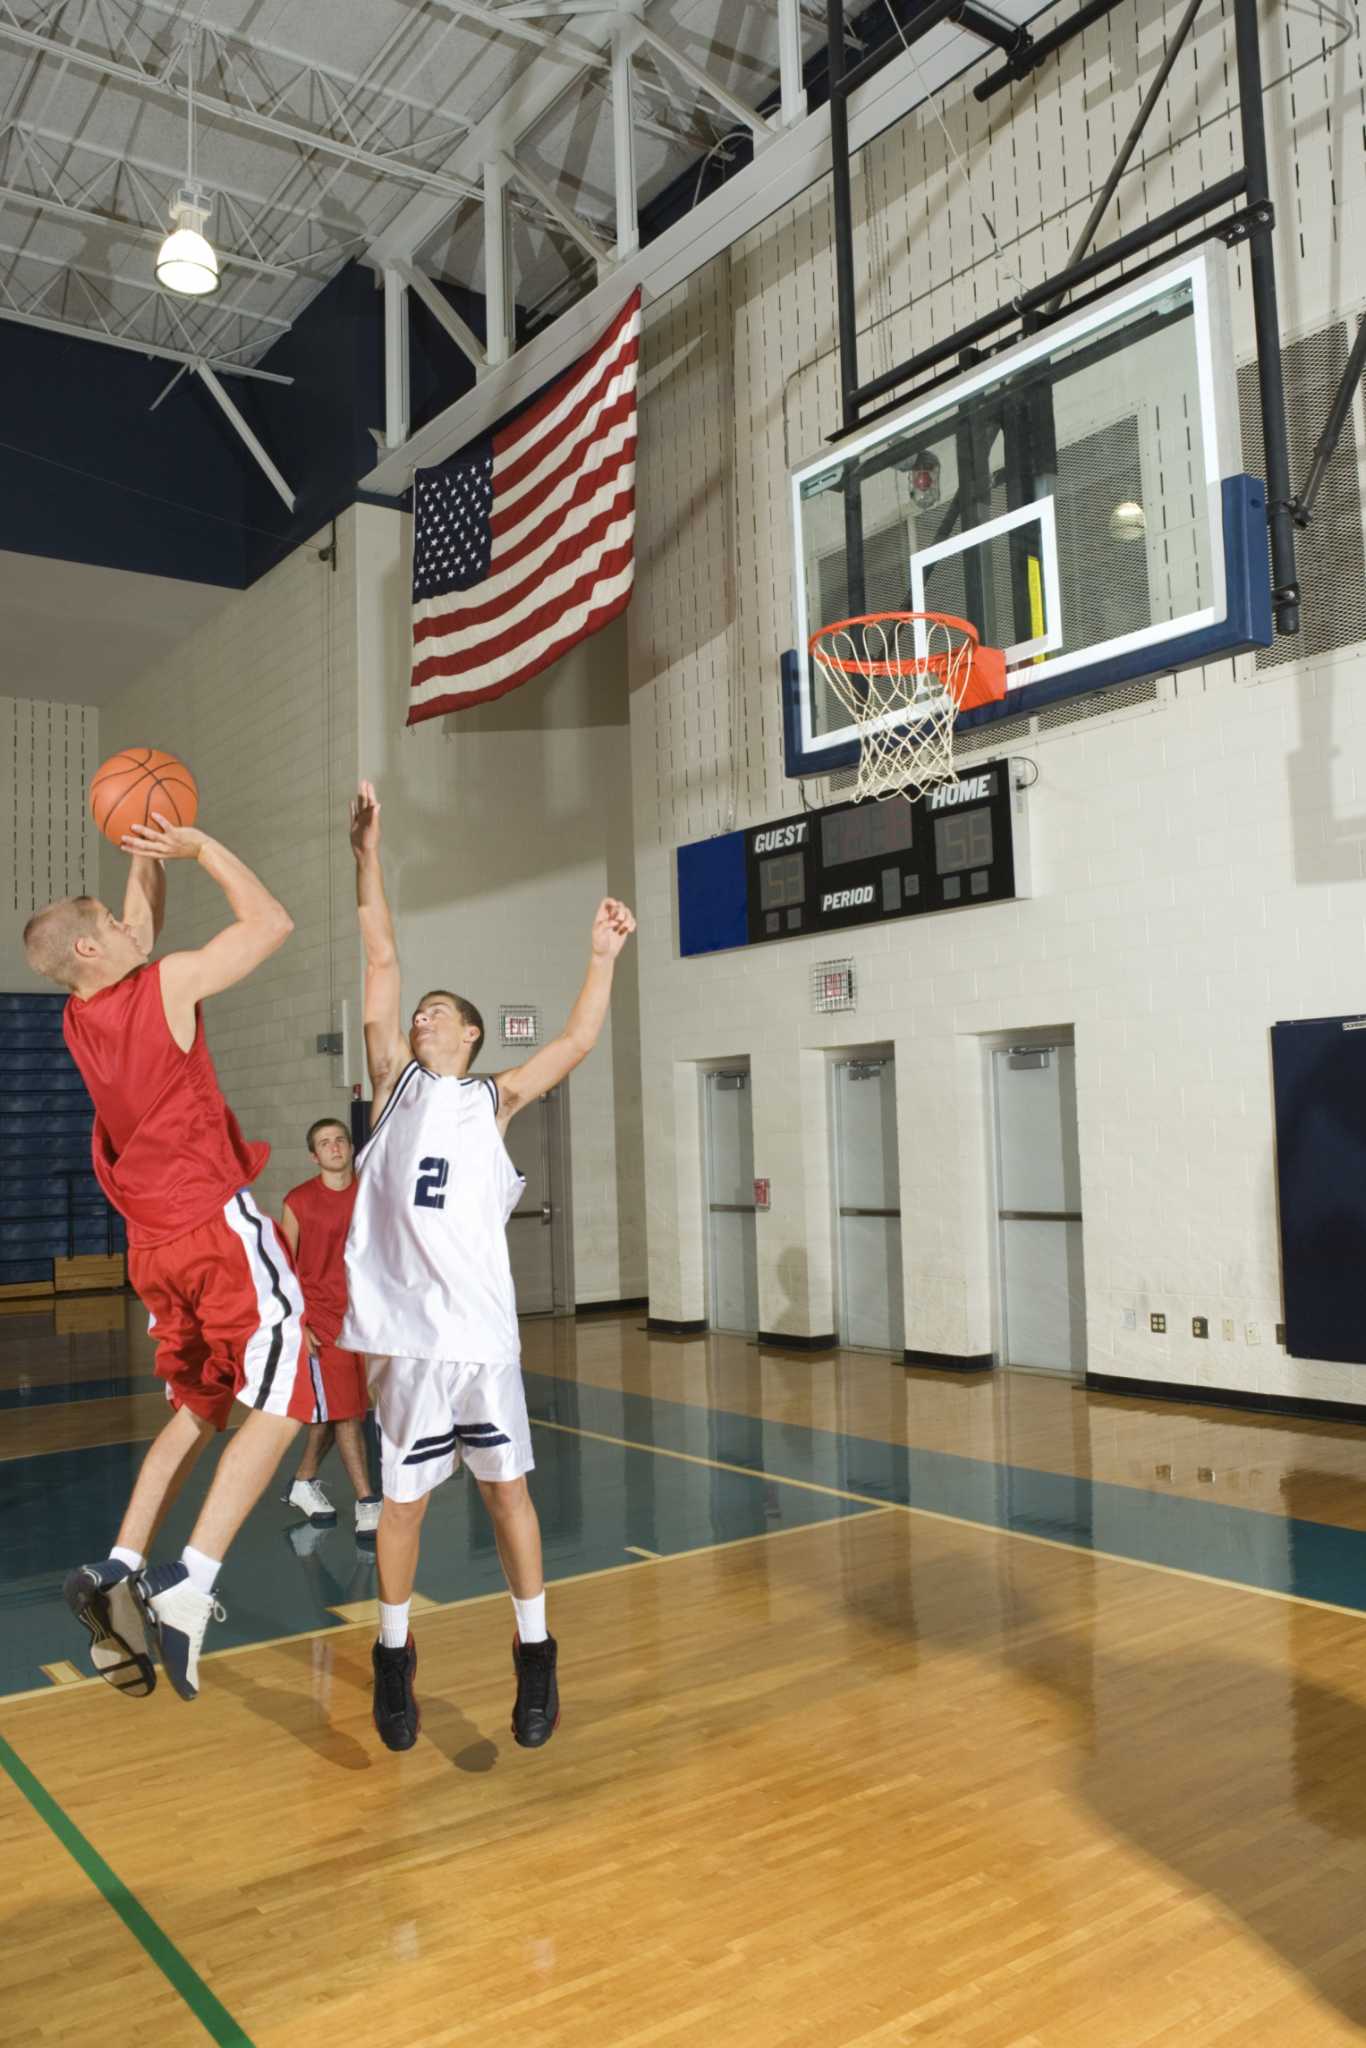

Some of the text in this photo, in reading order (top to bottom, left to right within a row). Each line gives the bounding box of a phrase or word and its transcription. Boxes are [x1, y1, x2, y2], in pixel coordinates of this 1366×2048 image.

[931, 774, 991, 810] HOME
[754, 822, 807, 853] GUEST
[822, 885, 874, 912] PERIOD
[414, 1156, 449, 1209] 2
